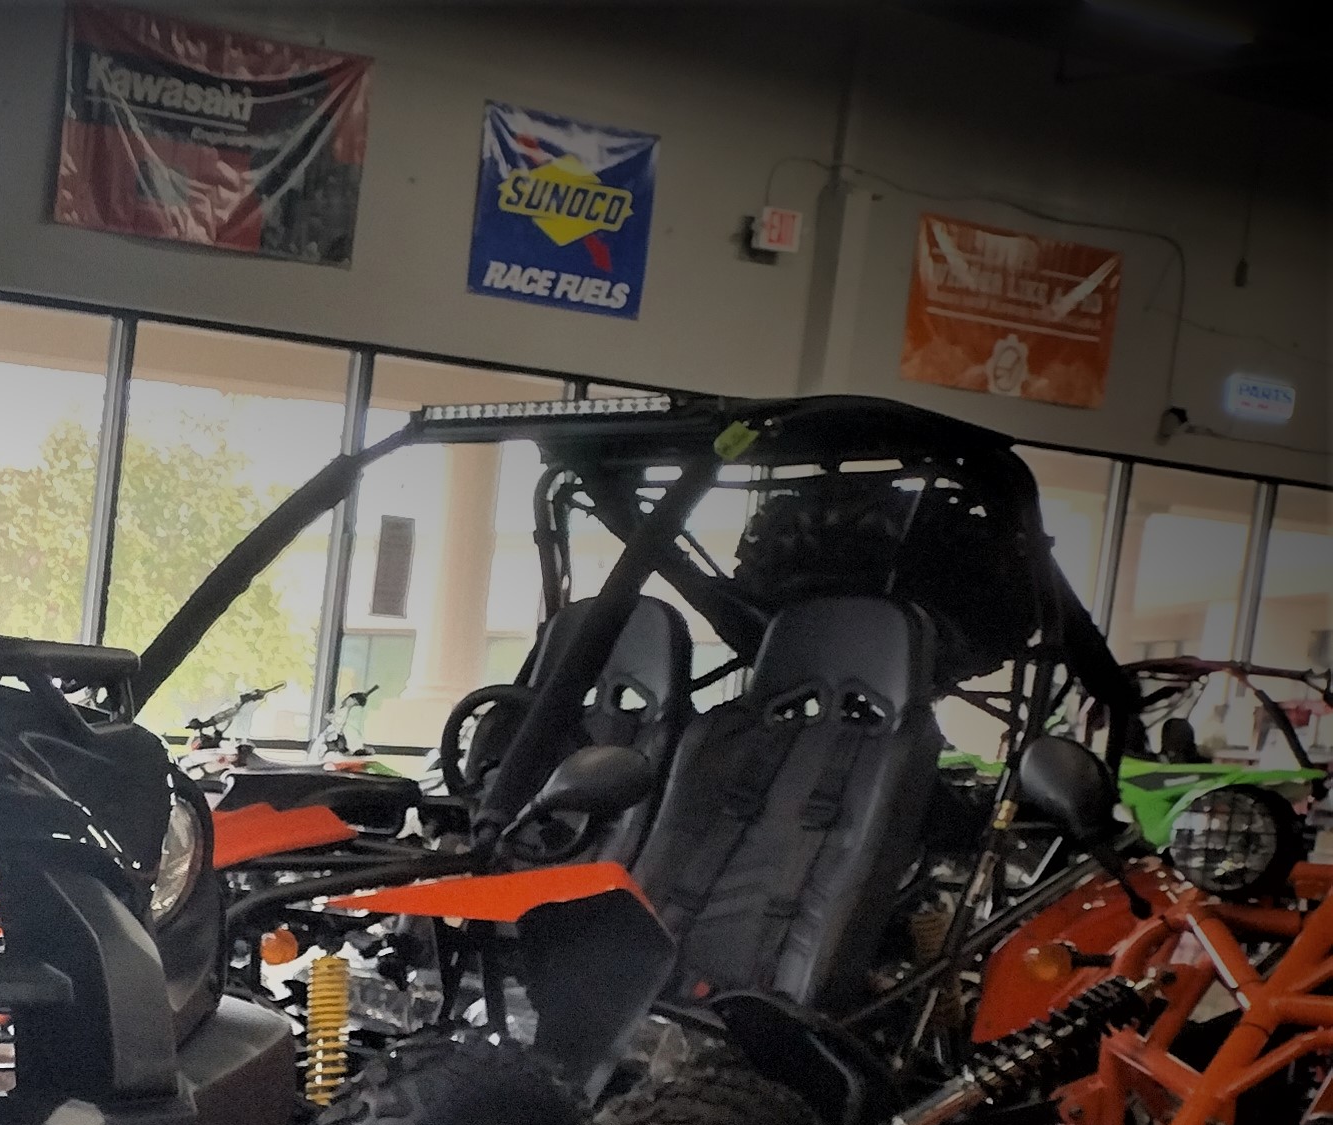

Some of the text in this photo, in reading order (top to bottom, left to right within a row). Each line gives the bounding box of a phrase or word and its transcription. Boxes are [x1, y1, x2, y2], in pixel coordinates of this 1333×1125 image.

[87, 51, 254, 122] Kawasaki
[505, 175, 626, 225] SUNOCO
[482, 259, 631, 310] RACE FUELS
